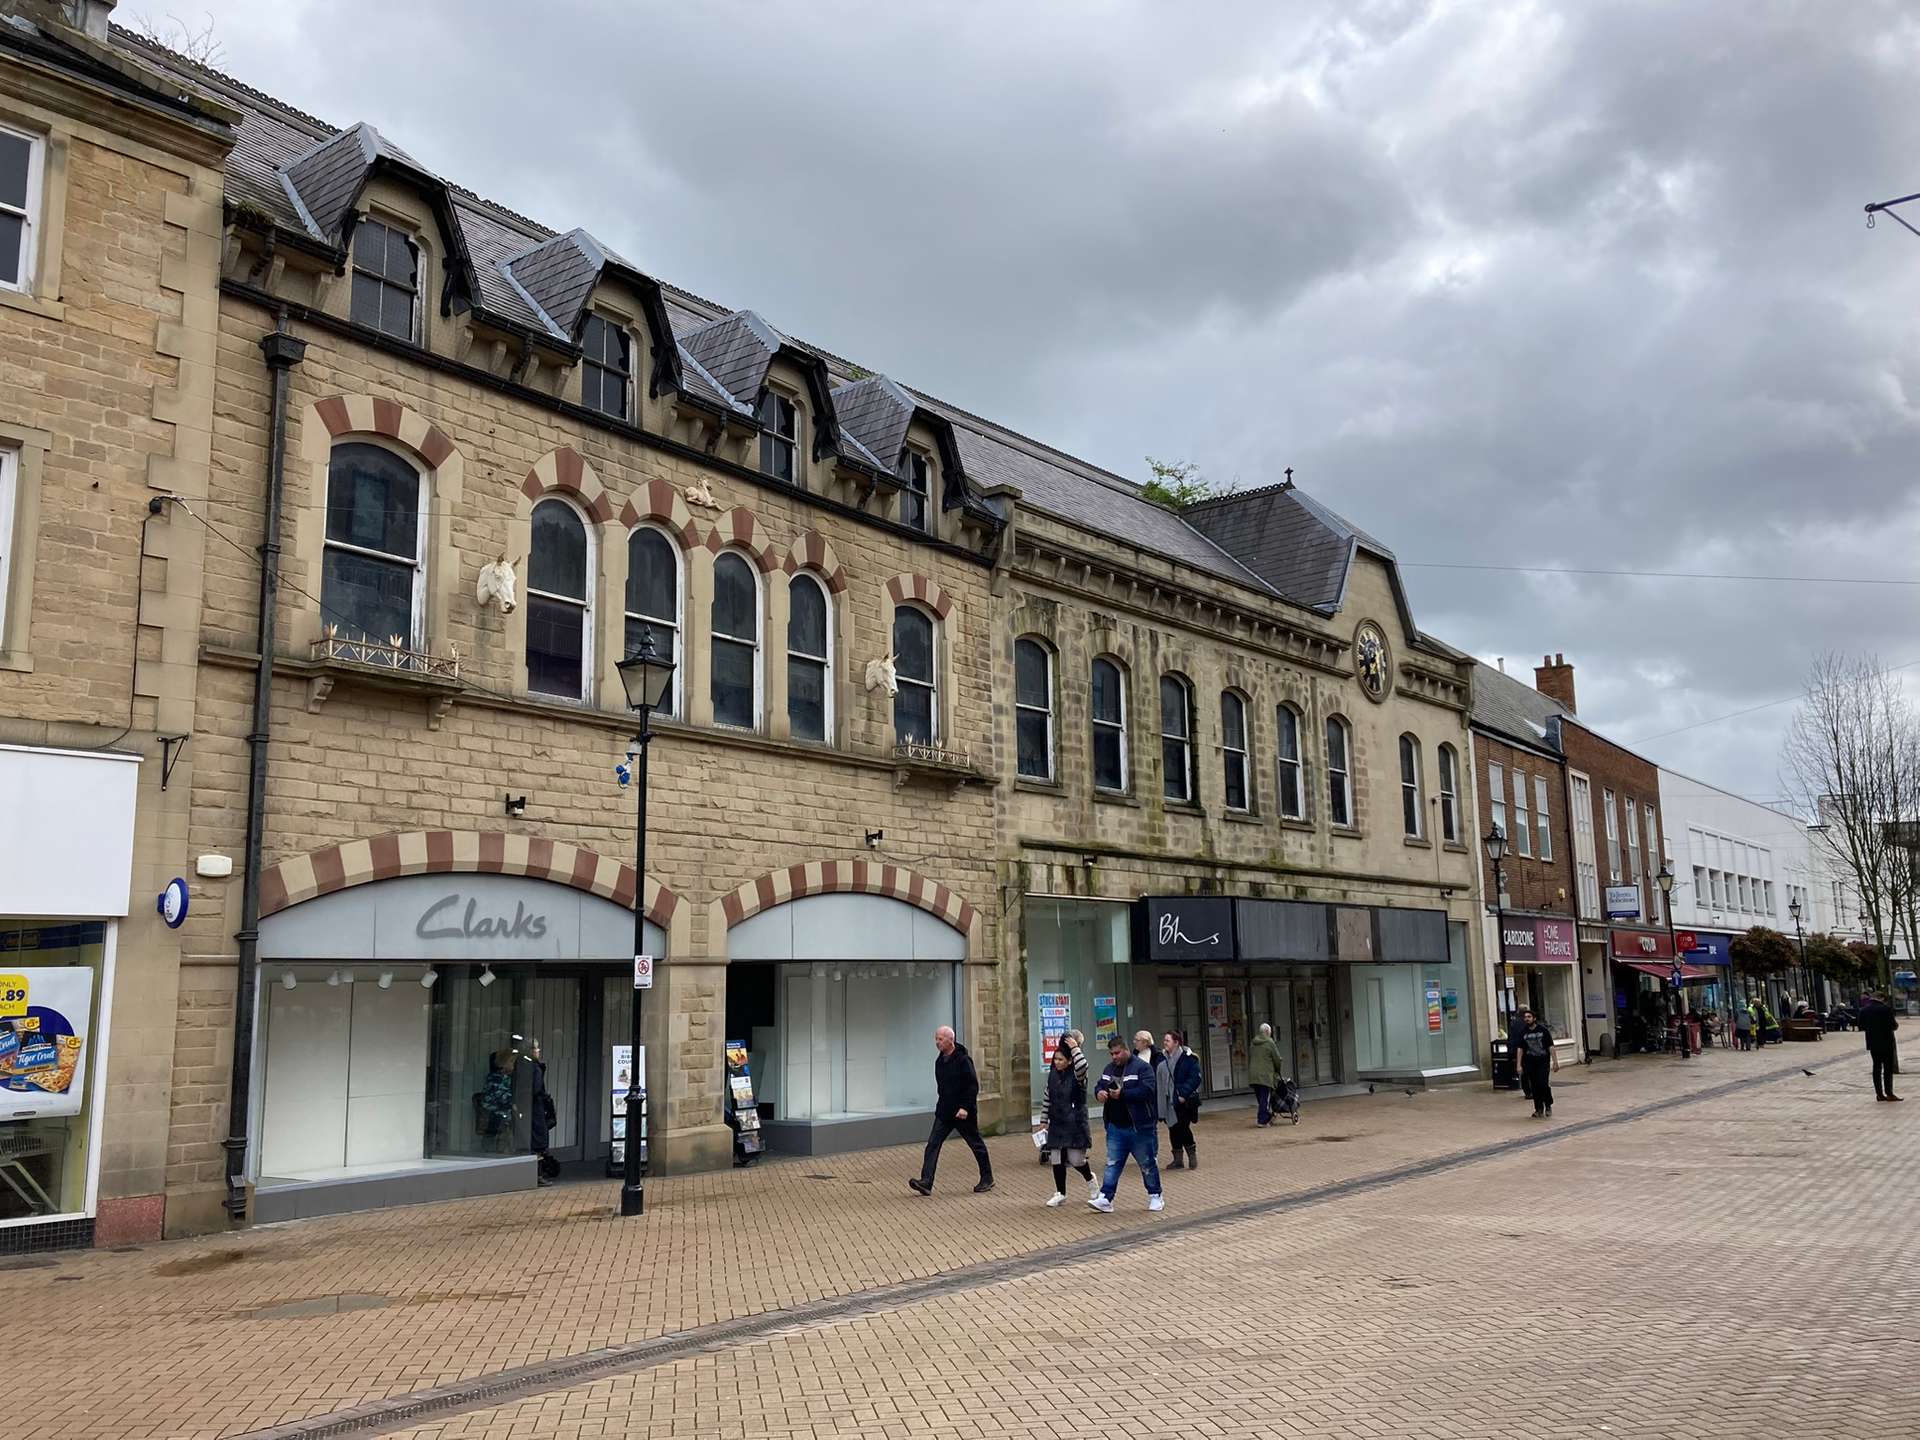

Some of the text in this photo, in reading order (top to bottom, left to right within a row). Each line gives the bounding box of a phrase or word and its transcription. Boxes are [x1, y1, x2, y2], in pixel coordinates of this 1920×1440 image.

[416, 894, 546, 939] Clarks
[1159, 912, 1220, 945] Bhs
[1543, 924, 1559, 940] HOME
[1503, 930, 1535, 946] CARDZONE
[1544, 940, 1572, 957] FRAGRANCE
[17, 1050, 55, 1066] Tiger Crust
